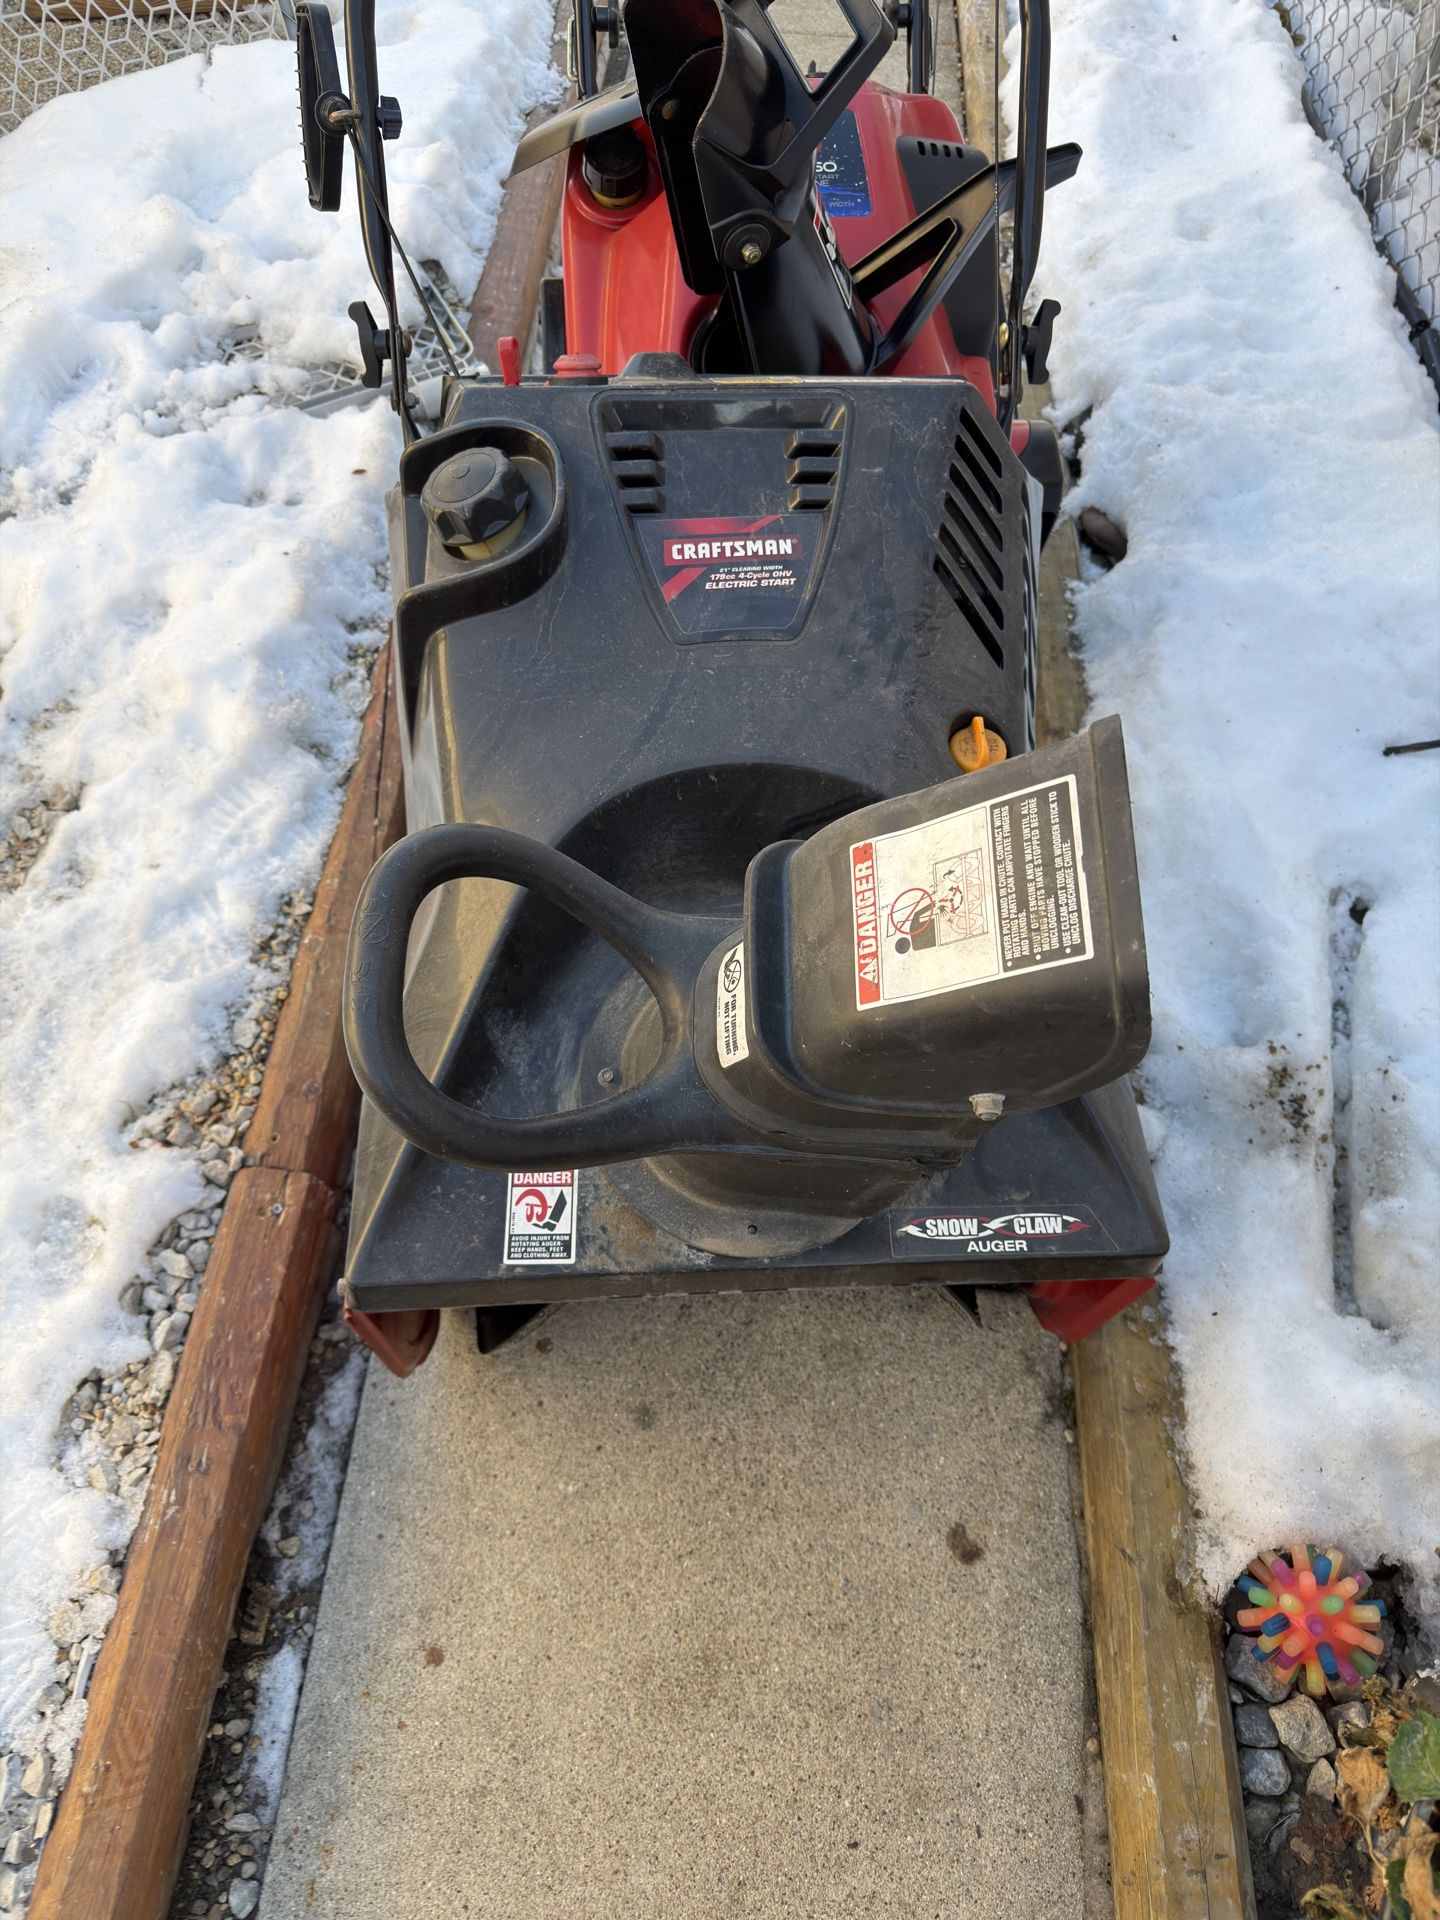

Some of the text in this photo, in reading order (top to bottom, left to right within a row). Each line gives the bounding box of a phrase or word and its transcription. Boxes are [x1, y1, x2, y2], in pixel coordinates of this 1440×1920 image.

[671, 538, 793, 560] CRAFTSMAN
[705, 578, 797, 590] ELECTRIC START
[709, 570, 793, 581] 179cc 4-Cycle OHV
[1022, 816, 1030, 840] UNTIL
[1024, 842, 1032, 862] WAIT
[1026, 864, 1034, 880] AND
[1029, 797, 1050, 952] MOVING PARTS HAVE STOPPED BEFORE
[1048, 790, 1071, 946] USE CLEAN-OUT TOOL OR WOODEN STICK TO
[993, 808, 1012, 960] NEVER PUT HAND IN CHUTE. CONTACT WITH
[1001, 805, 1020, 958] ROTATING PARTS CAN AMPUTATE FINGERS
[1062, 839, 1080, 944] UNCLOG DISCHARGE CHUTE.
[855, 859, 878, 956] DANGER
[1027, 881, 1036, 912] ENGINE
[1018, 909, 1029, 956] AND HANDS.
[1030, 914, 1039, 929] OFF
[1046, 894, 1059, 950] UNCLOGGING.
[1032, 931, 1041, 954] SHUT
[513, 1171, 572, 1185] DANGER
[925, 1216, 1064, 1236] SNOW CLAW
[967, 1240, 1028, 1253] AUGER
